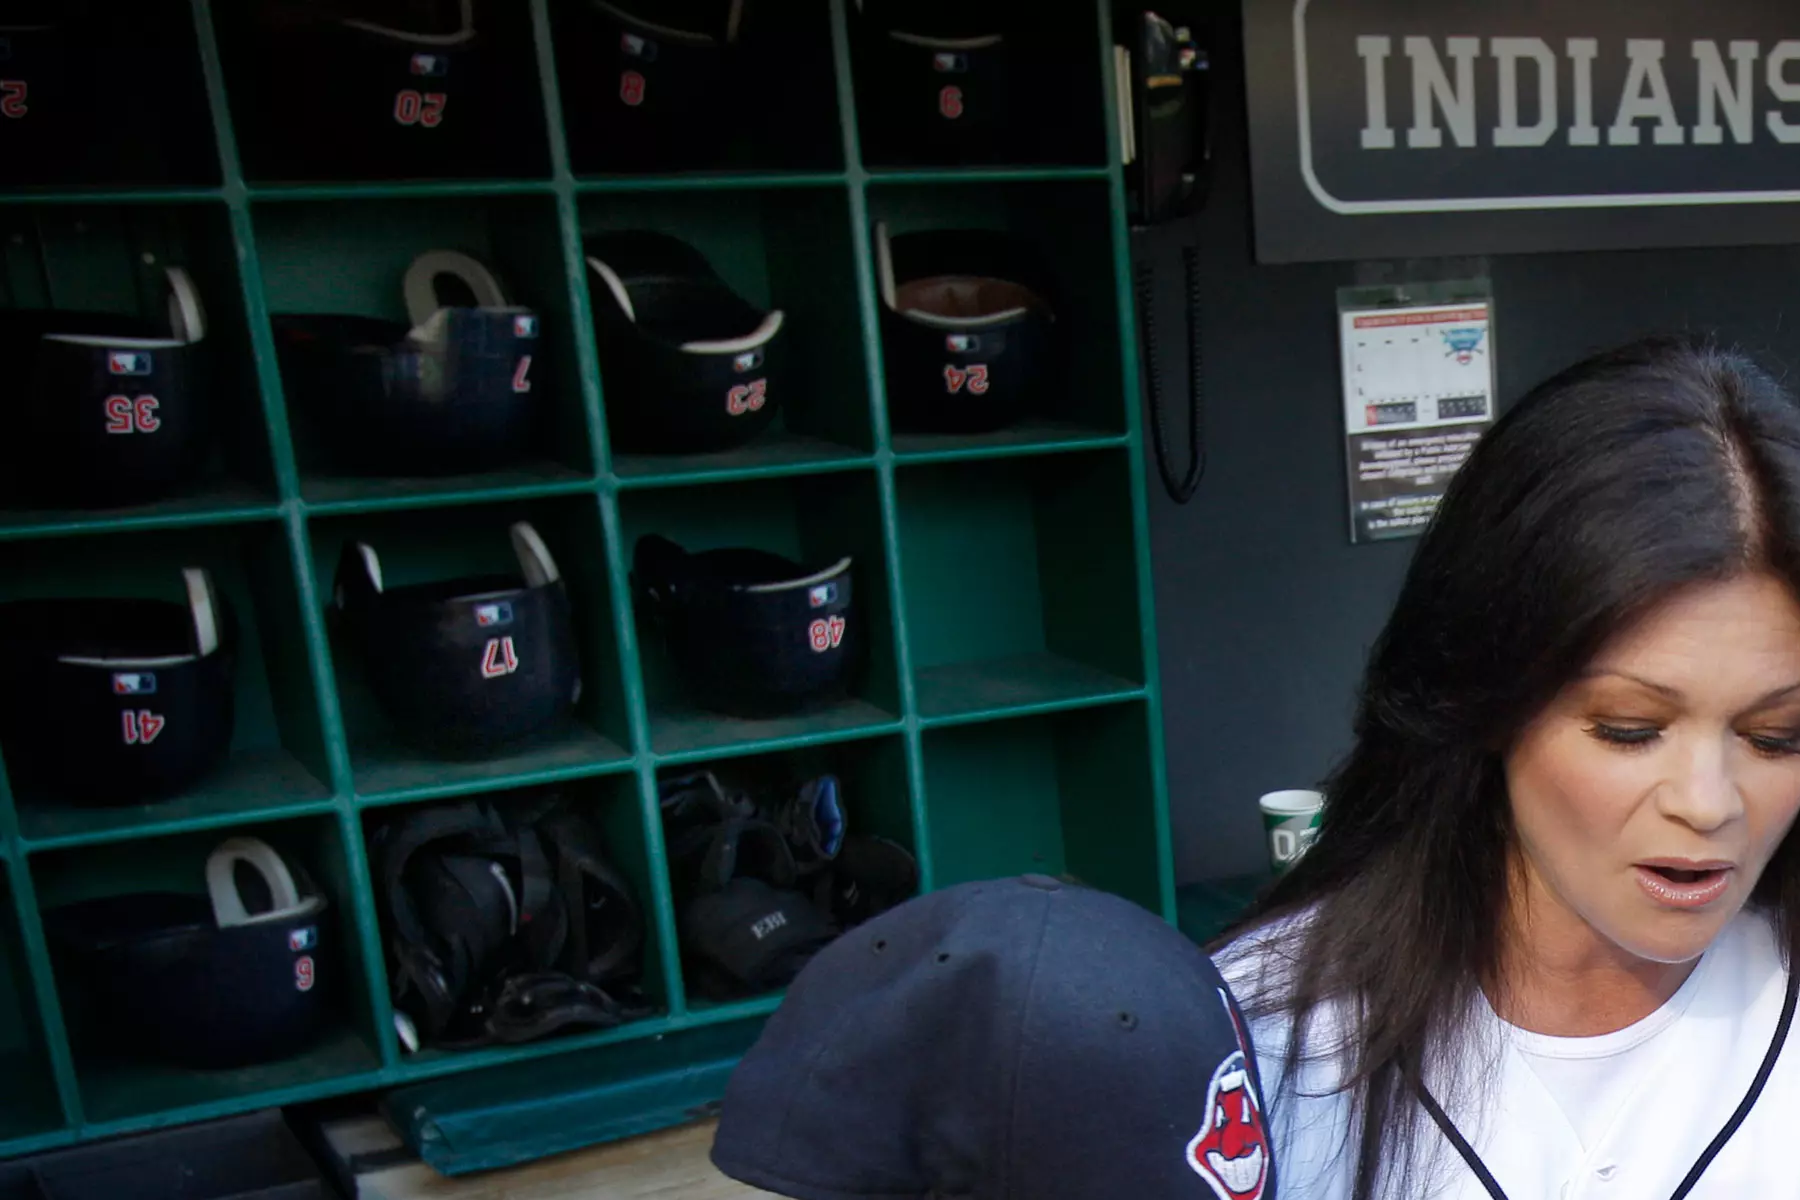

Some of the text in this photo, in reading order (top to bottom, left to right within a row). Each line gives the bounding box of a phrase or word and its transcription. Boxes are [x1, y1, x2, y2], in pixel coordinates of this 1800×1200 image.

[395, 89, 448, 128] 20
[621, 73, 645, 106] 8
[512, 355, 532, 393] 7
[943, 362, 991, 397] 24
[104, 395, 161, 433] 35
[726, 378, 768, 416] 23
[809, 614, 846, 653] 48
[480, 636, 520, 679] 17
[122, 709, 166, 745] 41
